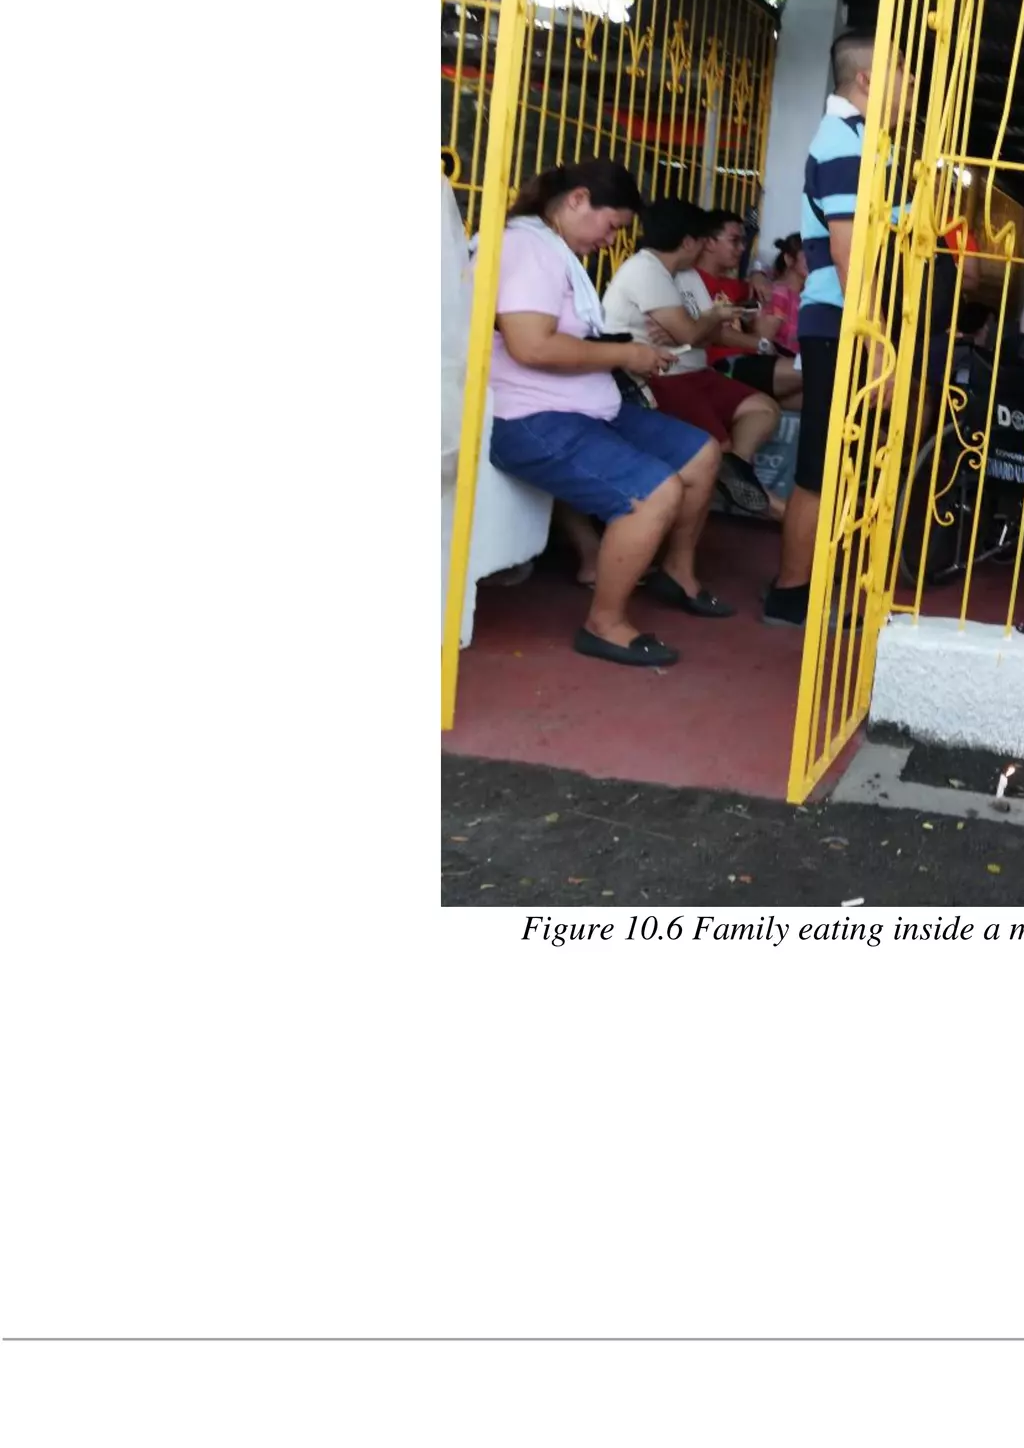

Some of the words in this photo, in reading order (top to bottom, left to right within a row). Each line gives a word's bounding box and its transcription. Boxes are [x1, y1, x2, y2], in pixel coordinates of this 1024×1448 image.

[522, 917, 614, 947] Figure
[625, 916, 683, 941] 10.6
[693, 916, 789, 947] Family
[799, 917, 883, 947] eating
[893, 916, 974, 941] inside
[983, 924, 999, 941] a
